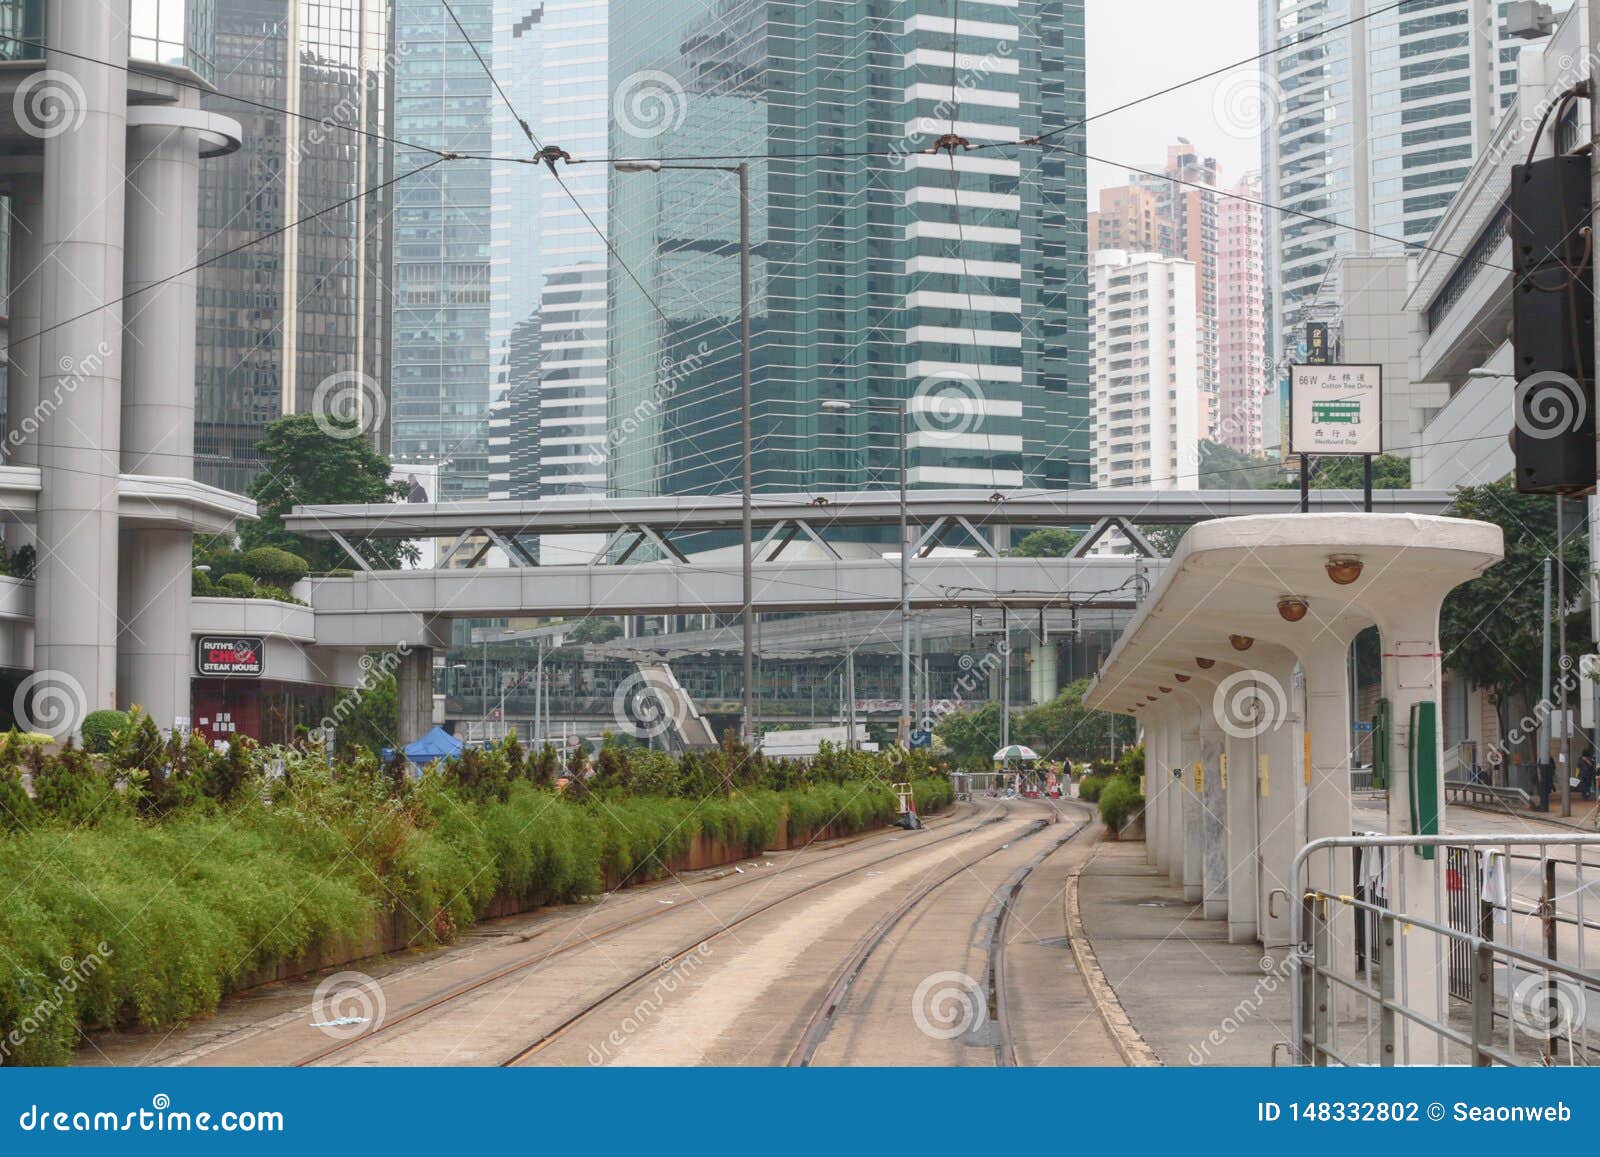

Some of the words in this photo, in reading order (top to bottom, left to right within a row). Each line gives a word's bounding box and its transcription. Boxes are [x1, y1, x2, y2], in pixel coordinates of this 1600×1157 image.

[204, 642, 234, 650] RUTH'S
[204, 663, 231, 671] STEAK
[232, 664, 260, 672] HOUSE
